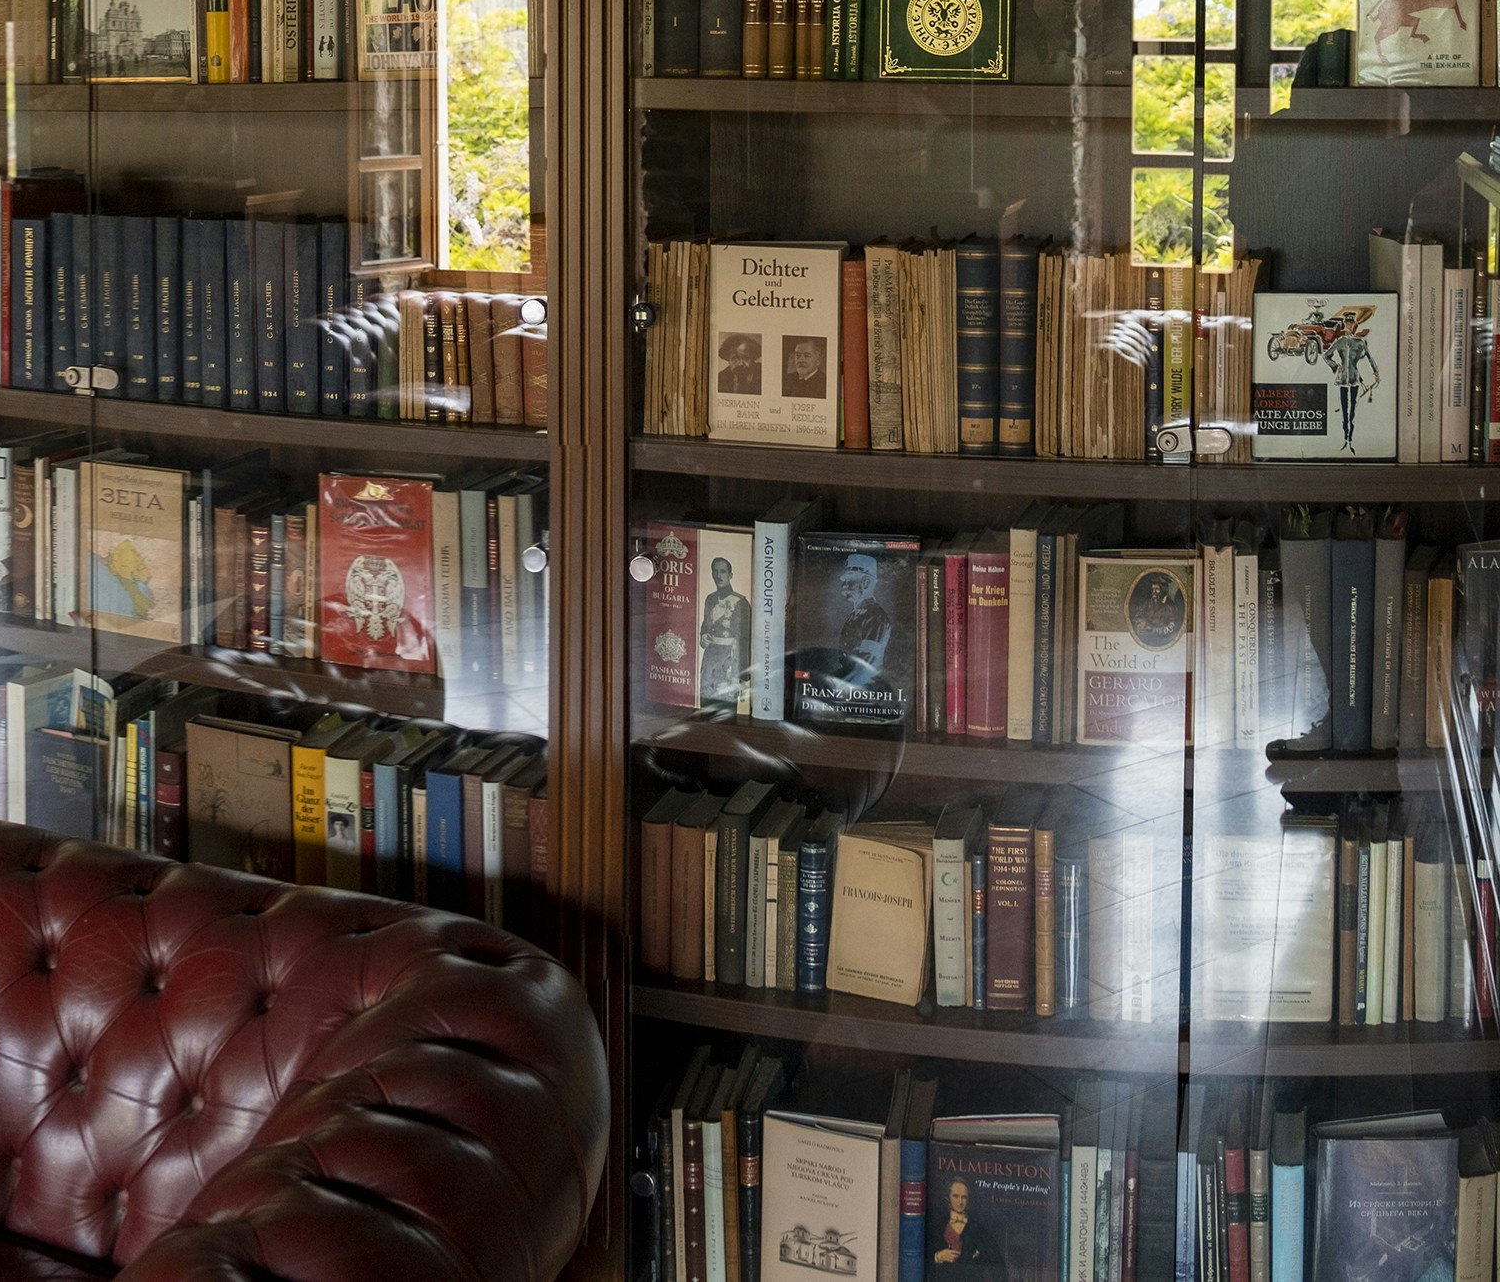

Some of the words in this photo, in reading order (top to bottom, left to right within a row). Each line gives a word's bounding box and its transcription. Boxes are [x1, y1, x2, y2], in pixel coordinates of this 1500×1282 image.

[742, 258, 809, 279] Dichter
[765, 279, 782, 288] und
[732, 289, 814, 310] Gelehrter
[100, 488, 165, 512] ЗЕТА
[663, 572, 678, 586] III
[764, 537, 773, 616] AGINCOURT
[652, 591, 690, 602] BULGARIA
[971, 585, 984, 596] Der
[985, 586, 1005, 598] Krieg
[979, 597, 1008, 607] Dunkeln
[1091, 635, 1120, 650] The
[1090, 653, 1137, 669] World
[1142, 653, 1159, 669] of
[1089, 677, 1163, 691] GERARD
[802, 683, 844, 698] FRANZ
[847, 687, 894, 702] JOSEPH
[1090, 693, 1186, 708] MERCATOR
[992, 846, 1007, 855] THE
[989, 855, 1013, 864] WORLD
[938, 1157, 1052, 1179] PALMERSTON
